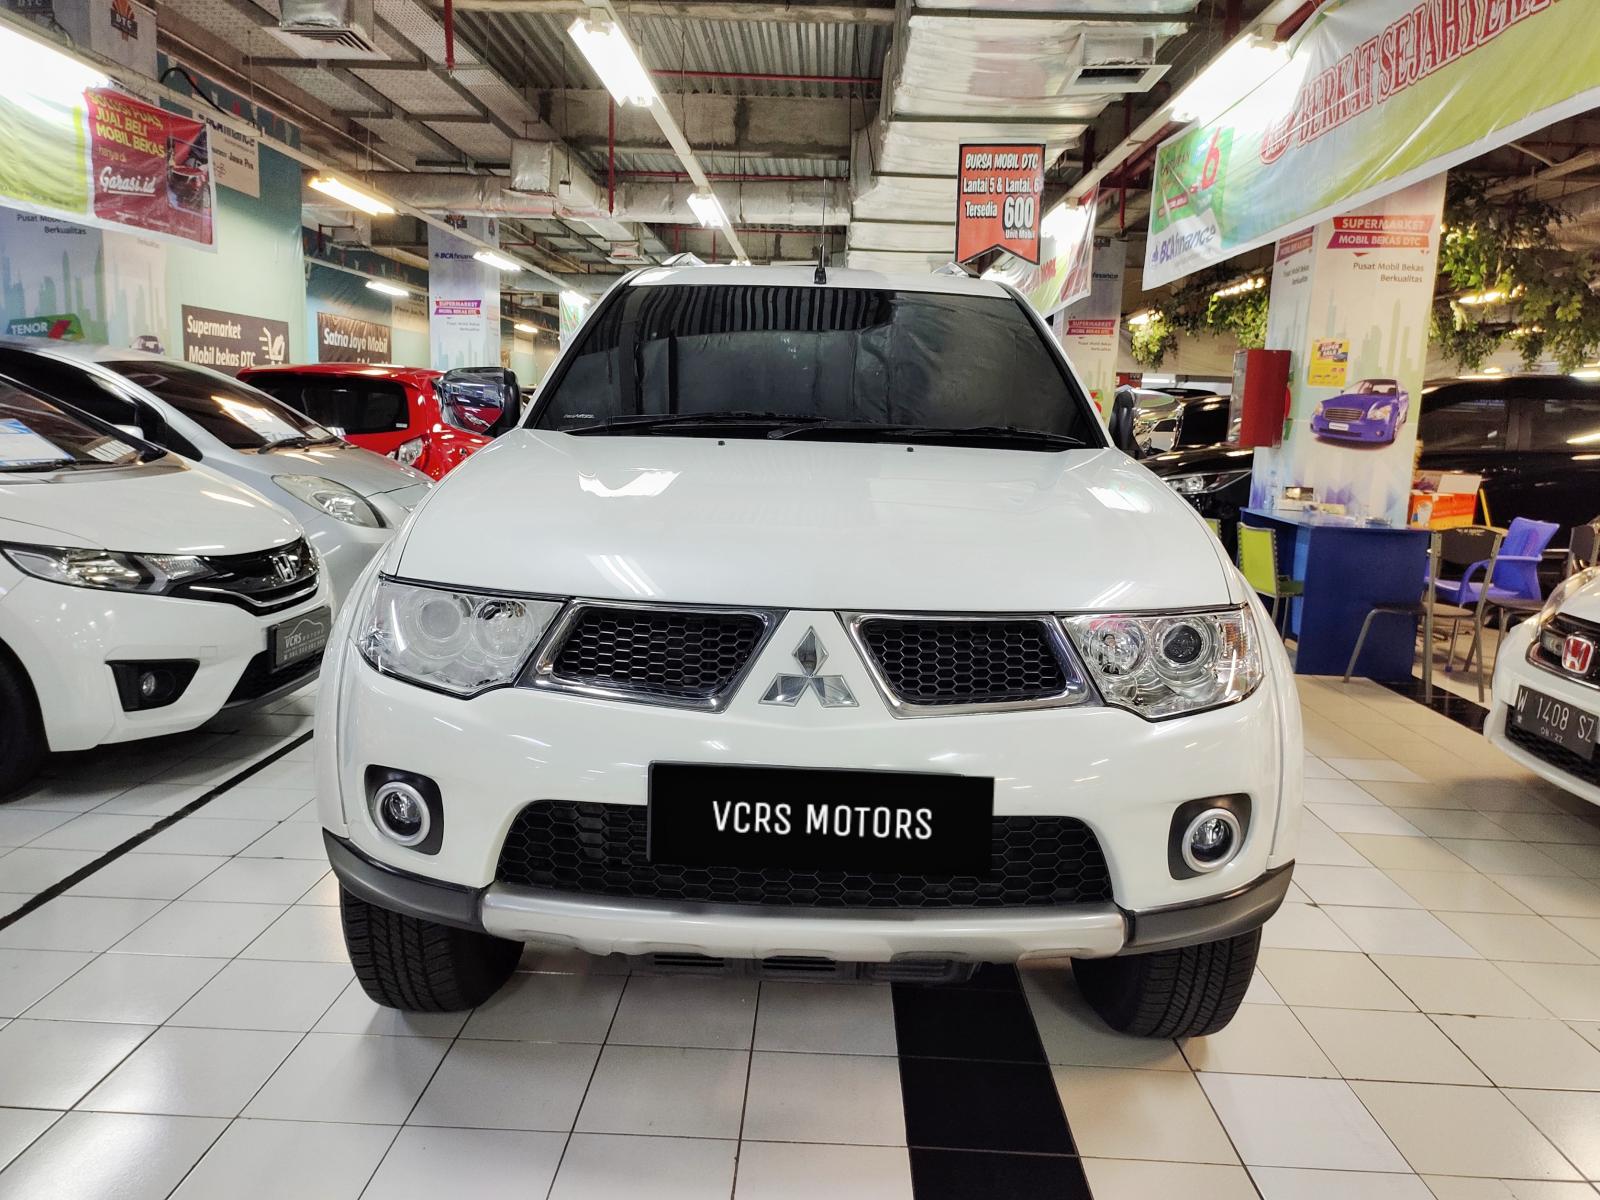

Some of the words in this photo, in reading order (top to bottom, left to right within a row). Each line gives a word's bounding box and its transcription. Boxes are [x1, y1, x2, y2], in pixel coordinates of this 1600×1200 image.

[116, 13, 132, 29] DTC
[1297, 36, 1379, 145] BERKAT
[96, 107, 123, 128] JUAL
[125, 116, 148, 138] BELI
[96, 122, 131, 147] MOBIL
[132, 133, 166, 159] BEKAS
[965, 153, 993, 170] BURSA
[994, 153, 1020, 170] MOBIL
[1021, 153, 1040, 170] DTC
[100, 166, 157, 194] Garasi.id
[963, 177, 988, 194] Lantai
[989, 177, 995, 193] 5
[996, 177, 1003, 193] &
[966, 201, 998, 218] Tersedia
[1003, 196, 1035, 229] 600
[1342, 218, 1425, 230] SUPERMARKET
[1339, 235, 1369, 245] MOBIL
[1371, 235, 1400, 245] BEKAS
[1403, 236, 1422, 246] DTC
[1353, 262, 1376, 271] Pusat
[1377, 262, 1400, 272] Mobil
[1401, 263, 1424, 272] Bekas
[1380, 273, 1423, 283] Berkualitas
[11, 322, 48, 335] TENOR
[187, 315, 241, 339] Supermarket
[324, 328, 349, 349] Satria
[367, 336, 388, 353] Mobil
[189, 345, 214, 363] Mobil
[216, 347, 240, 366] bekas
[241, 351, 256, 367] DTC
[1517, 689, 1528, 713] W
[1536, 697, 1569, 731] 1408
[1578, 715, 1595, 743] SZ
